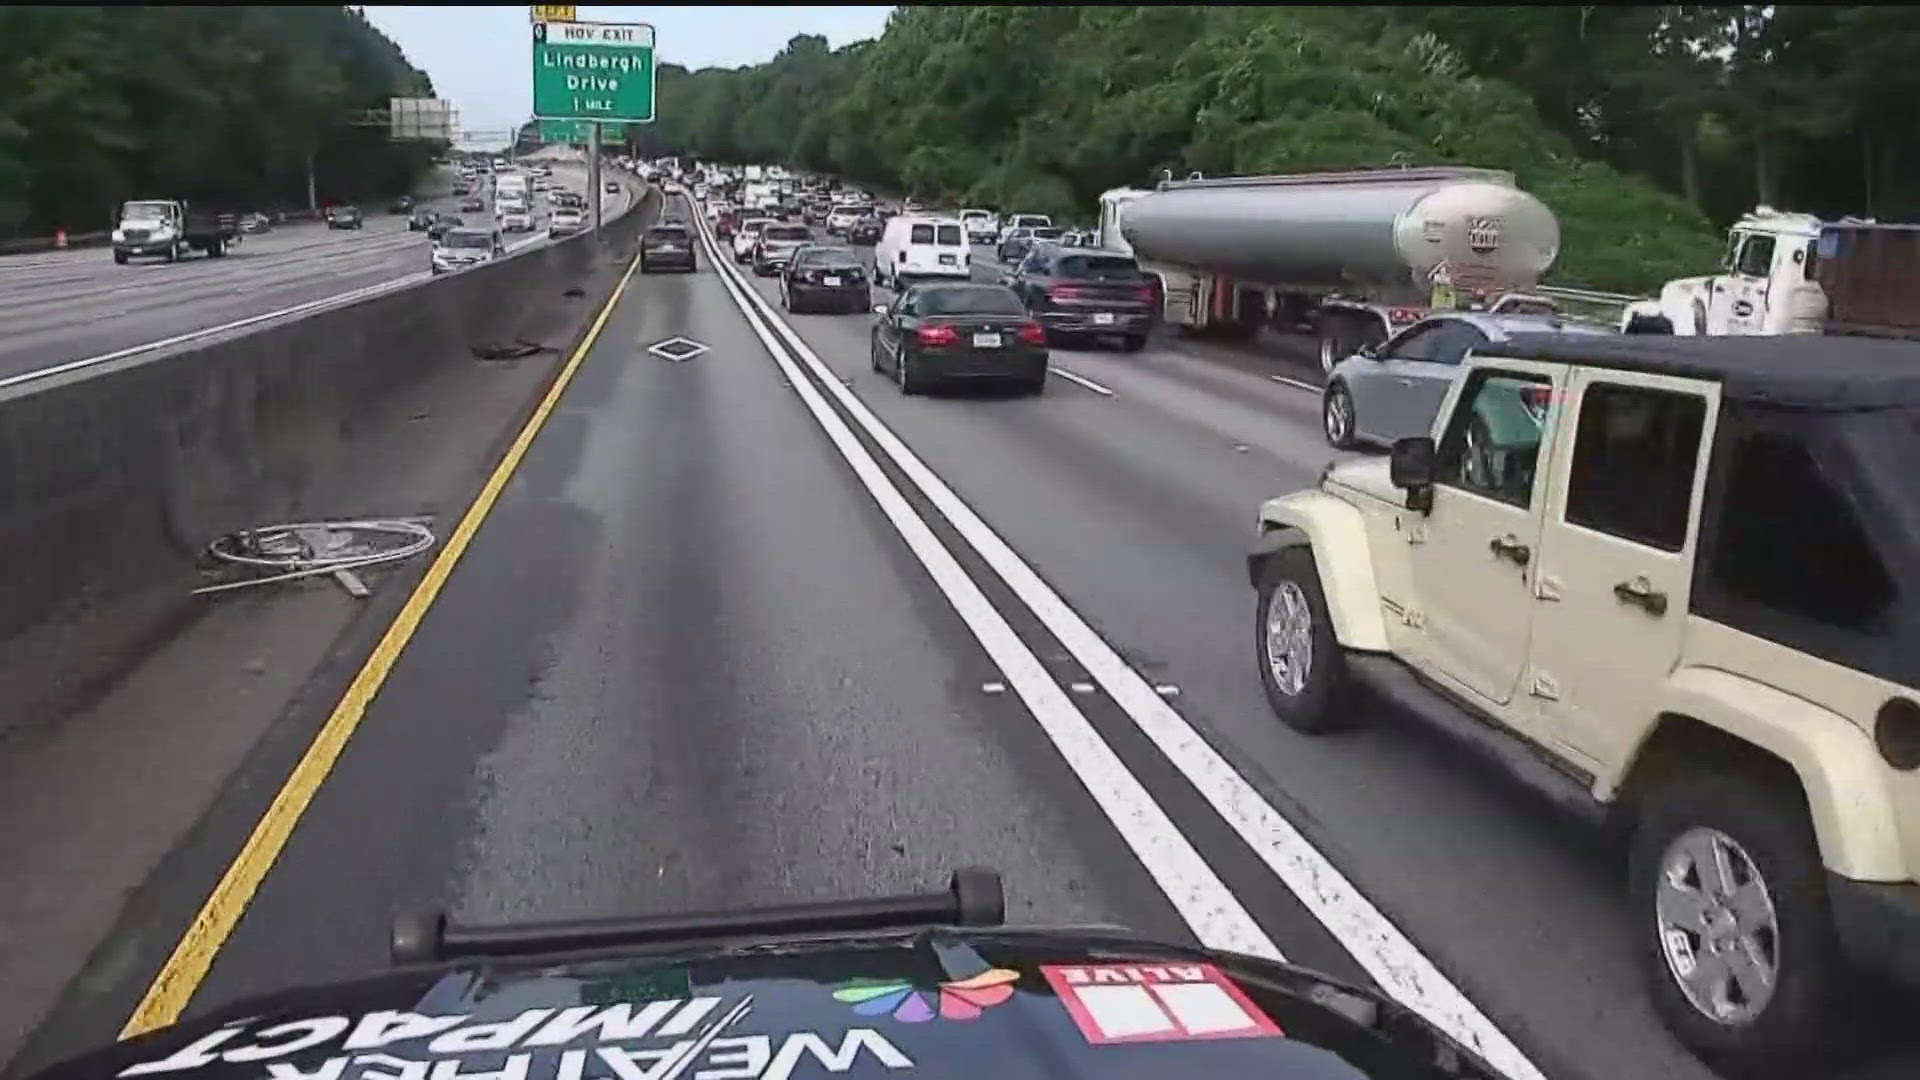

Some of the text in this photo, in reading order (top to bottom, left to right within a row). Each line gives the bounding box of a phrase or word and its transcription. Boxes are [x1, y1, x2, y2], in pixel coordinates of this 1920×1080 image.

[565, 28, 634, 41] HOV EXIT
[543, 51, 642, 73] Lindbergh
[567, 75, 618, 91] Drive
[573, 97, 579, 112] 1
[1061, 967, 1205, 983] ALIVE
[115, 997, 722, 1078] IMPACT
